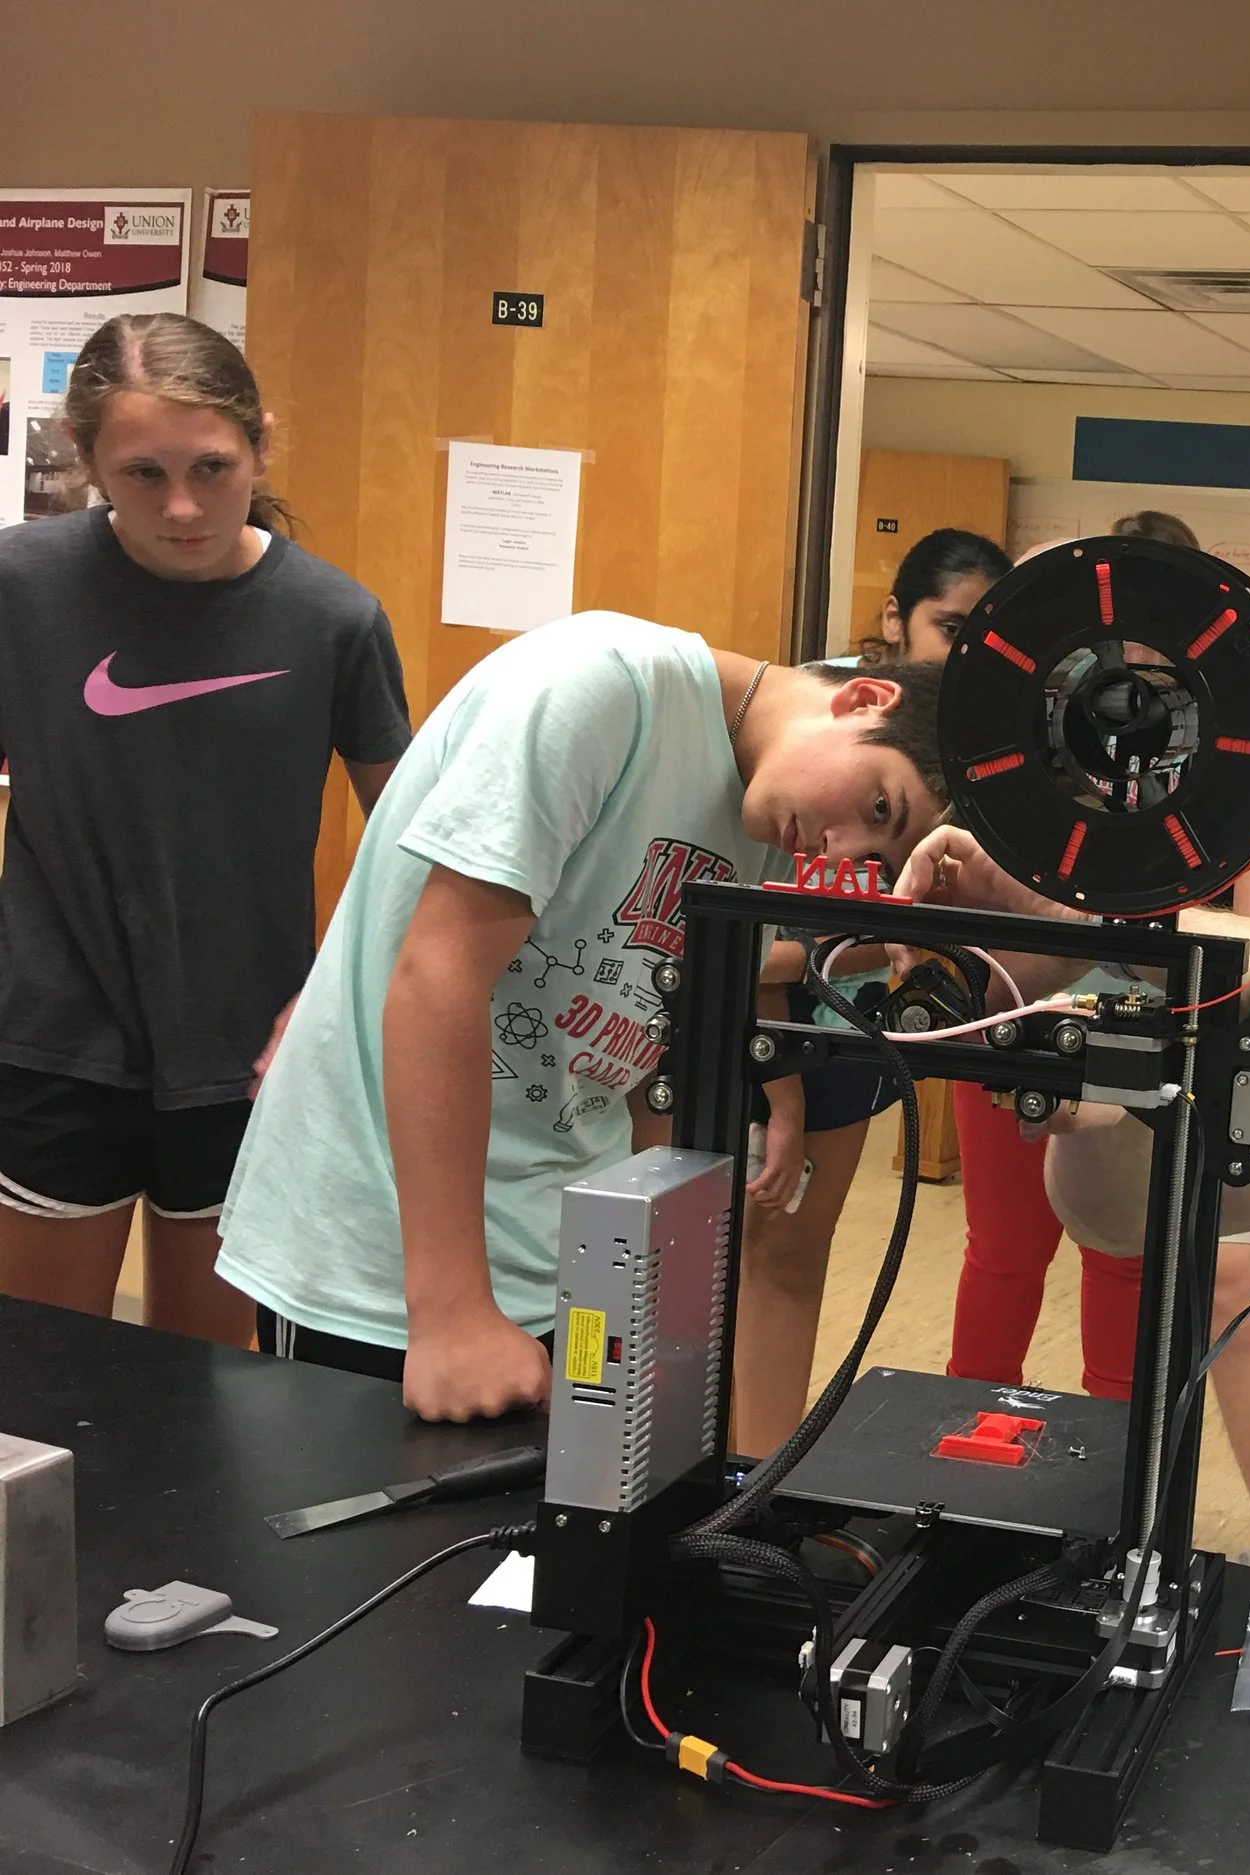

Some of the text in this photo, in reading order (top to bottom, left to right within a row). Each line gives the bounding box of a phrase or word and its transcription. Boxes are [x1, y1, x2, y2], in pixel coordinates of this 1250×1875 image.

[19, 217, 64, 231] Airplane
[67, 218, 103, 231] Design
[132, 215, 175, 228] UNION
[54, 250, 81, 258] Matthew
[82, 250, 102, 258] Owen
[20, 261, 48, 276] Spring
[49, 262, 71, 273] 2018
[8, 278, 56, 292] Engineering
[59, 279, 112, 293] Department
[497, 299, 538, 321] B-39
[470, 461, 559, 474] Engineering Research Workstations
[554, 994, 669, 1070] 3D PRINTIN
[568, 1051, 631, 1090] CAMP
[989, 1387, 1064, 1403] Ender
